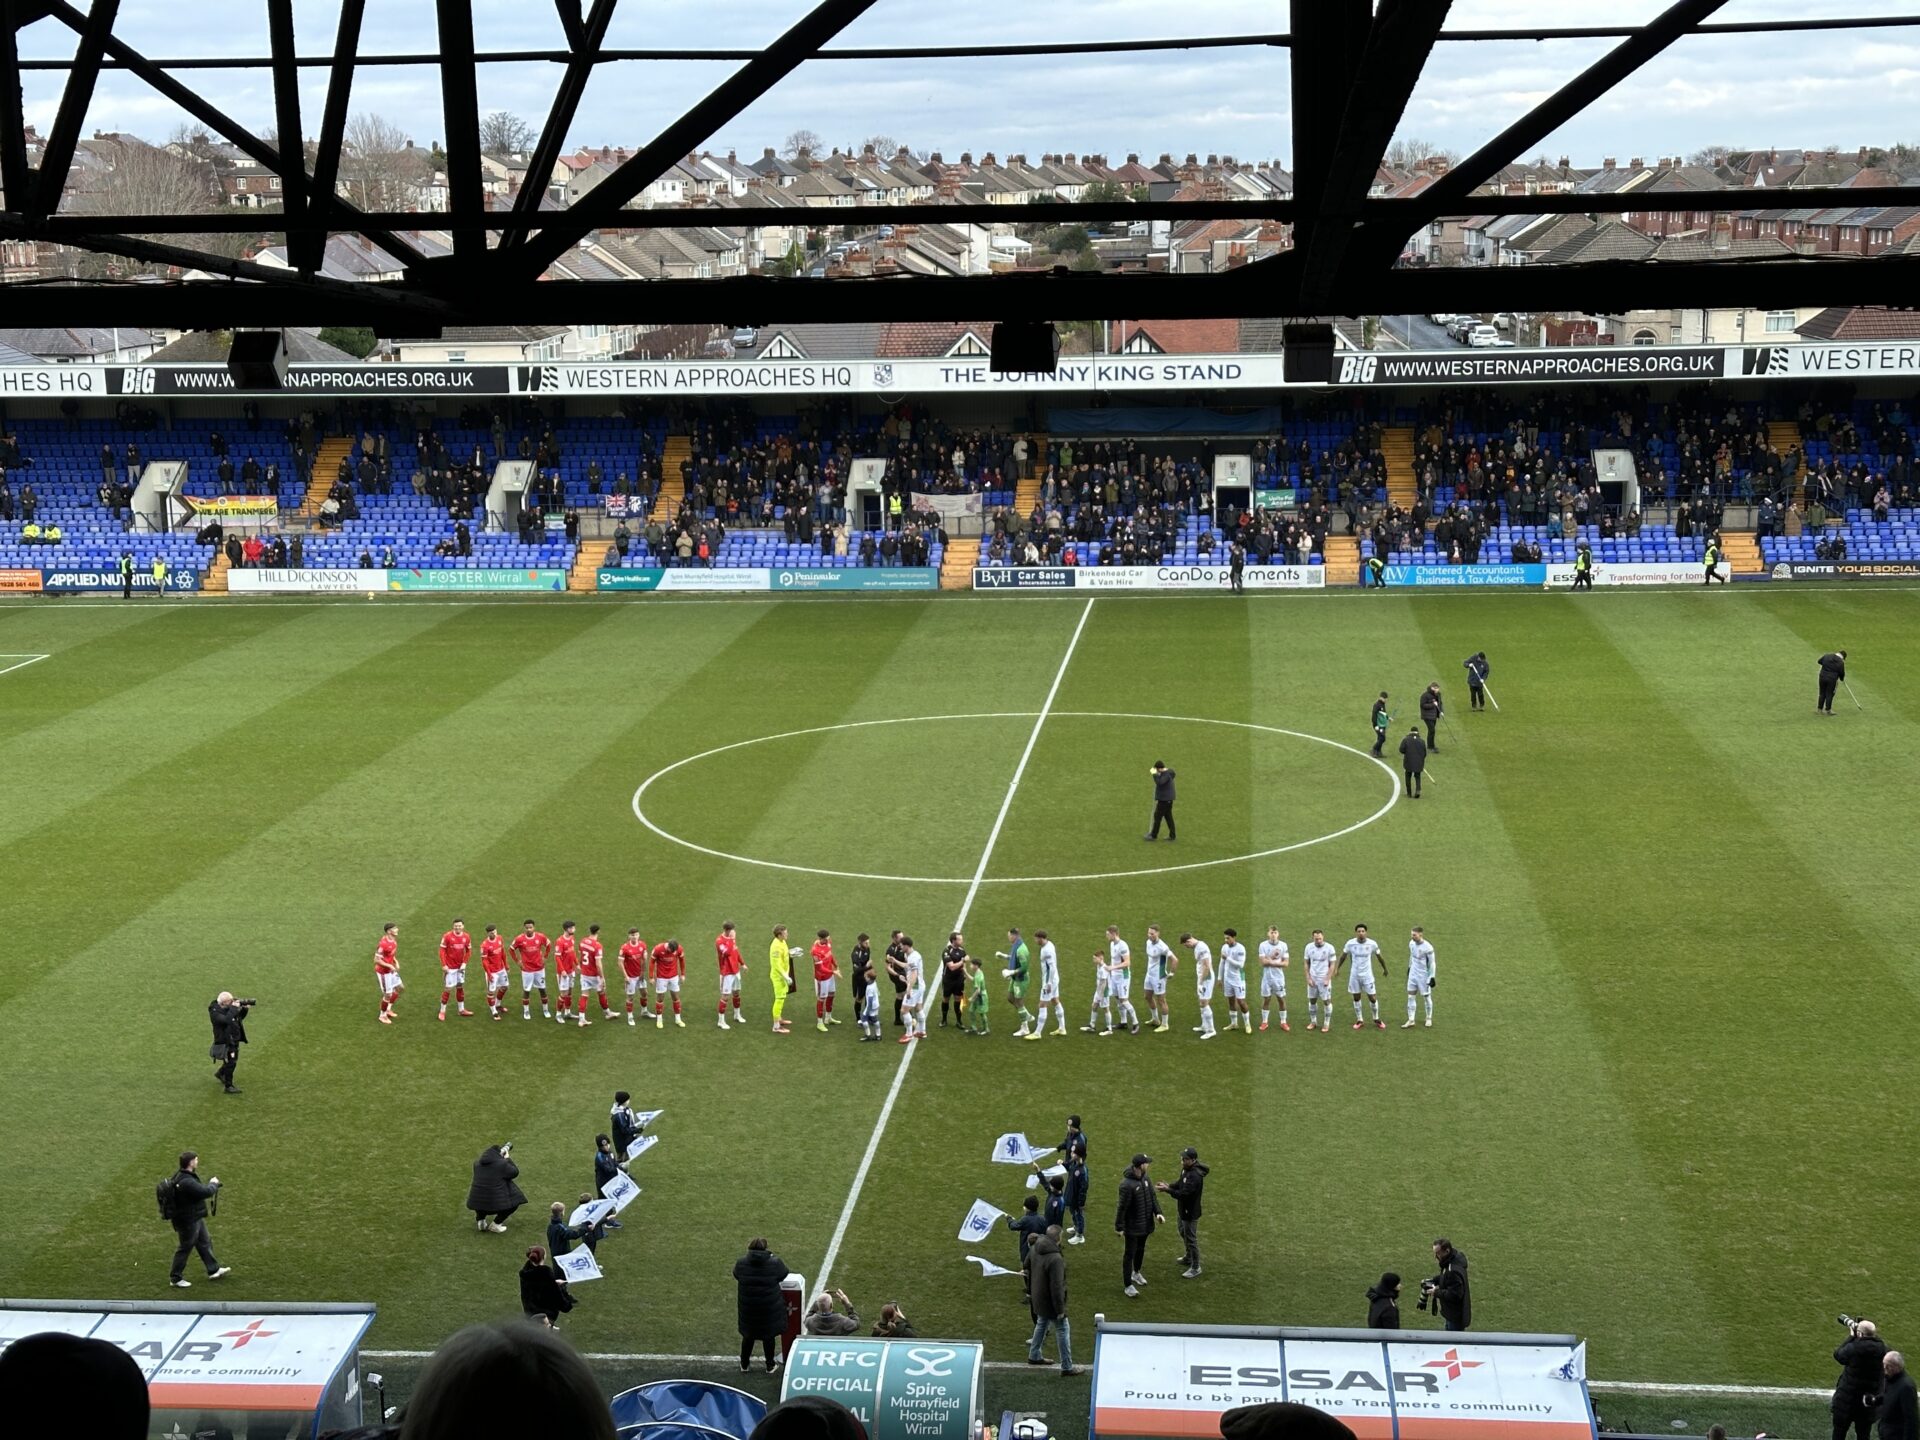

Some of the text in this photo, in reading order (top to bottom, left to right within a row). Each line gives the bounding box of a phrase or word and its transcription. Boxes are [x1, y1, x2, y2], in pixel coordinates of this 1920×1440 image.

[1384, 355, 1715, 377] WWW.WESTERNAPPROACHES.ORG.UK
[174, 371, 475, 388] WWW.WRNAPPROACHES.ORG.UK
[567, 366, 852, 390] WESTERN APPROACHES HQ
[941, 364, 1242, 384] THE JOHNNY KING STAND
[60, 372, 93, 393] HQ
[199, 507, 276, 516] WE ARE TRANMERE!
[1017, 571, 1066, 580] Car Sales
[1416, 564, 1525, 575] Chartered Accountants
[1793, 565, 1920, 573] IGNITE YOUR SOCIAL
[46, 573, 99, 586] APPLIED
[487, 571, 522, 583] Wirral
[1416, 574, 1525, 585] Business & Tax Advisers
[1609, 572, 1667, 582] Transforming
[1670, 573, 1683, 581] for
[582, 951, 590, 966] 3
[798, 1350, 879, 1367] TRFC
[208, 1367, 302, 1377] community
[1189, 1365, 1440, 1393] ESSAR
[791, 1377, 873, 1392] OFFICIAL
[905, 1382, 946, 1398] Spire
[890, 1396, 960, 1410] Murrayfield
[1124, 1390, 1177, 1400] Proud
[1186, 1393, 1203, 1401] to
[1211, 1393, 1233, 1402] be
[1315, 1398, 1344, 1406] the
[1352, 1398, 1441, 1409] Tranmere
[1449, 1401, 1553, 1413] community
[899, 1409, 949, 1423] Hospital
[905, 1423, 942, 1435] Wirral
